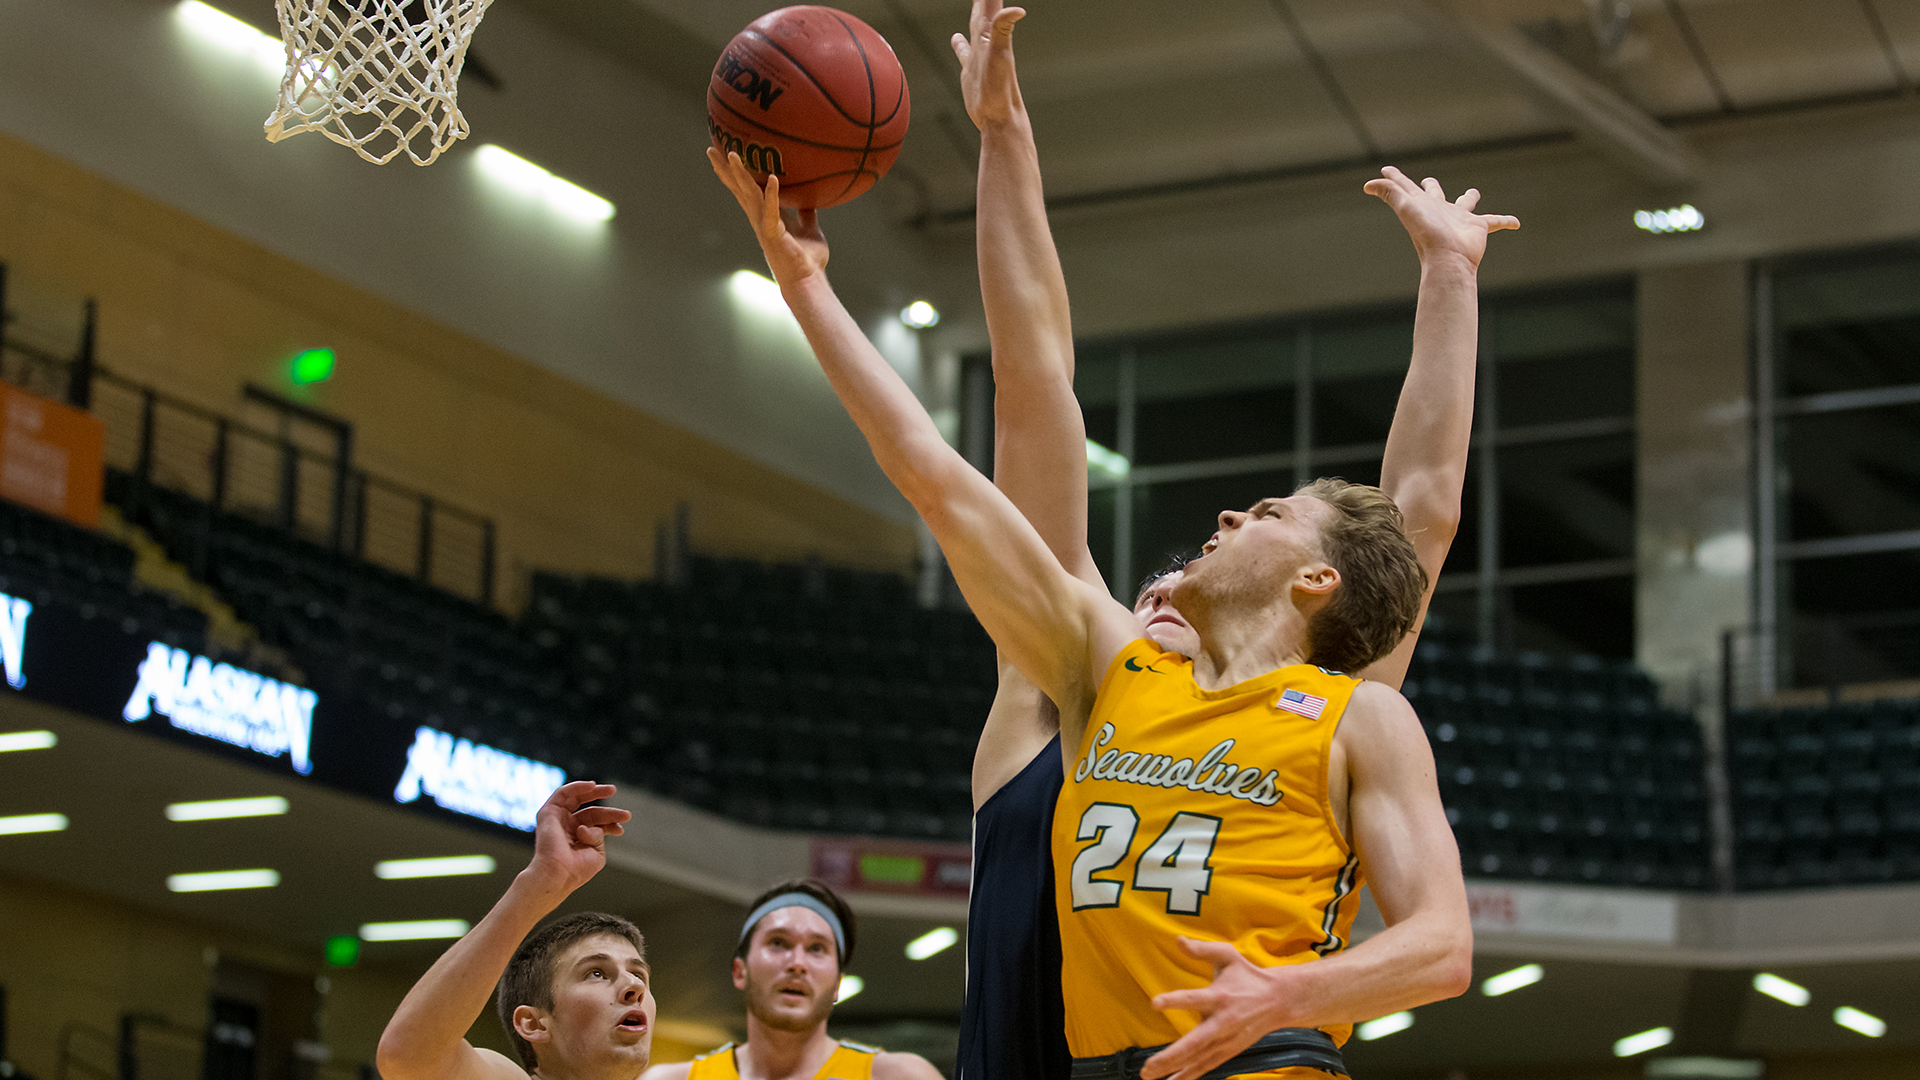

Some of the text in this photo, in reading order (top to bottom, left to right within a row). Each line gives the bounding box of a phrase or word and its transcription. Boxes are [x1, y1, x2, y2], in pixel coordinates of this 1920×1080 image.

[123, 641, 318, 775] ALASKAN
[1075, 721, 1284, 807] Seawolves
[1070, 801, 1223, 917] 24
